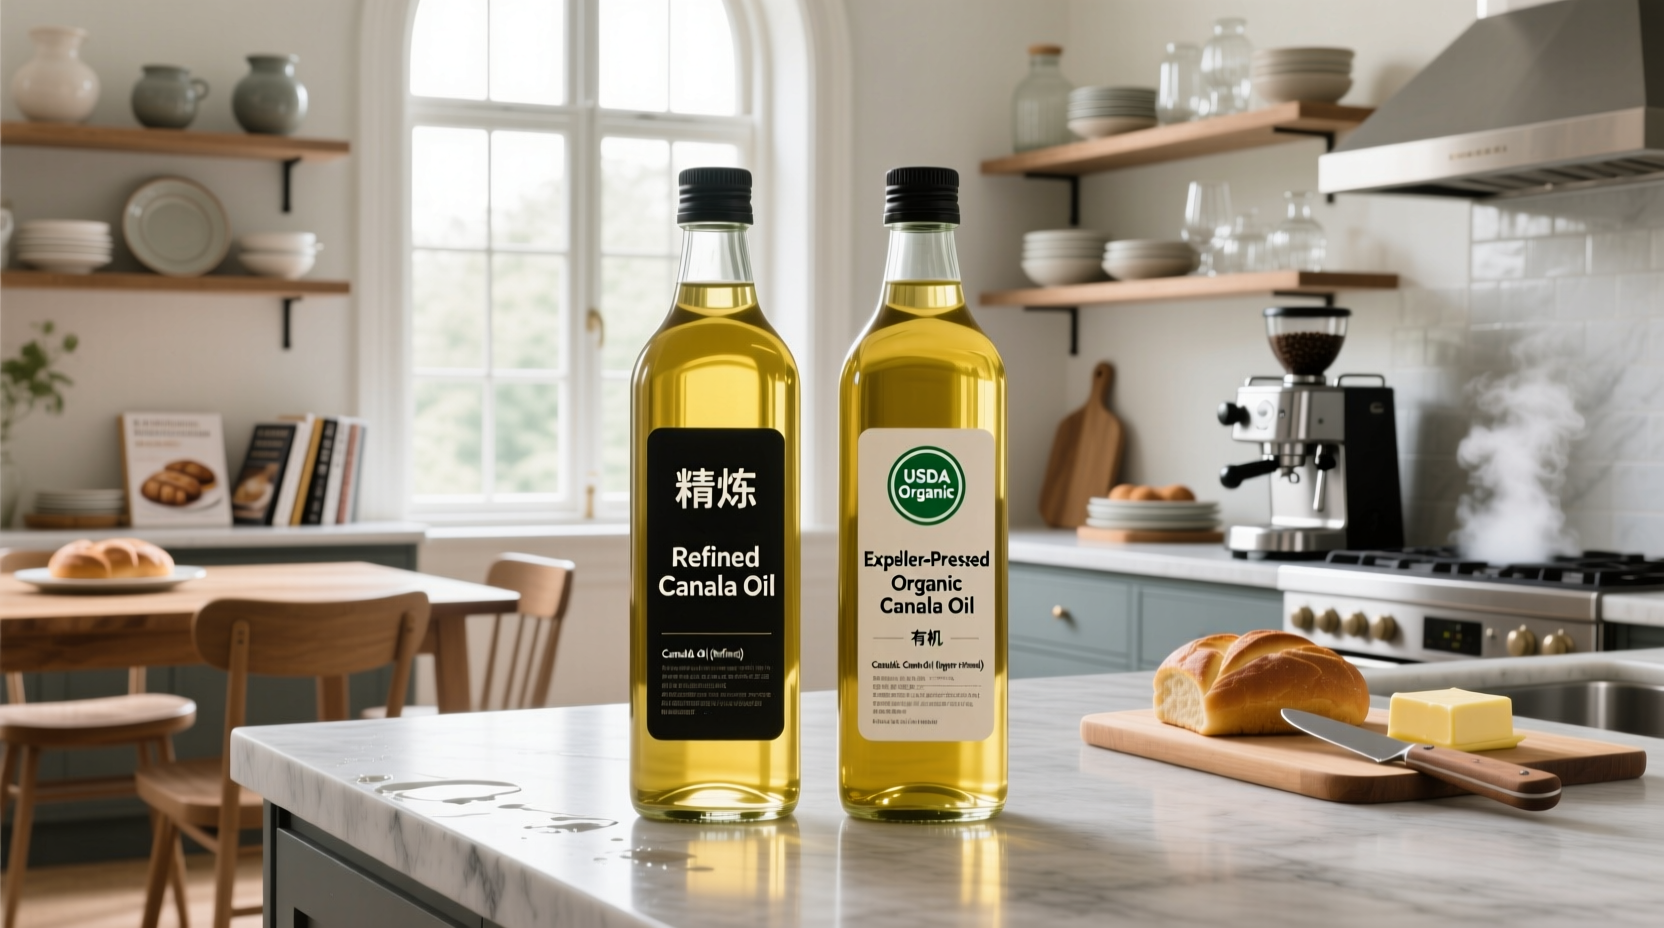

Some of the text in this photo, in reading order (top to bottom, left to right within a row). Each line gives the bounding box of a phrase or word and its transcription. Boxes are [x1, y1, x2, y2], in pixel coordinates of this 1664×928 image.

[903, 468, 951, 484] USDA
[675, 467, 757, 510] 精炼
[898, 485, 955, 502] Organic
[672, 546, 760, 568] Refined
[658, 574, 775, 597] Canala Oil
[891, 574, 963, 597] Organic
[948, 596, 974, 614] Oil
[910, 629, 944, 647] 有机
